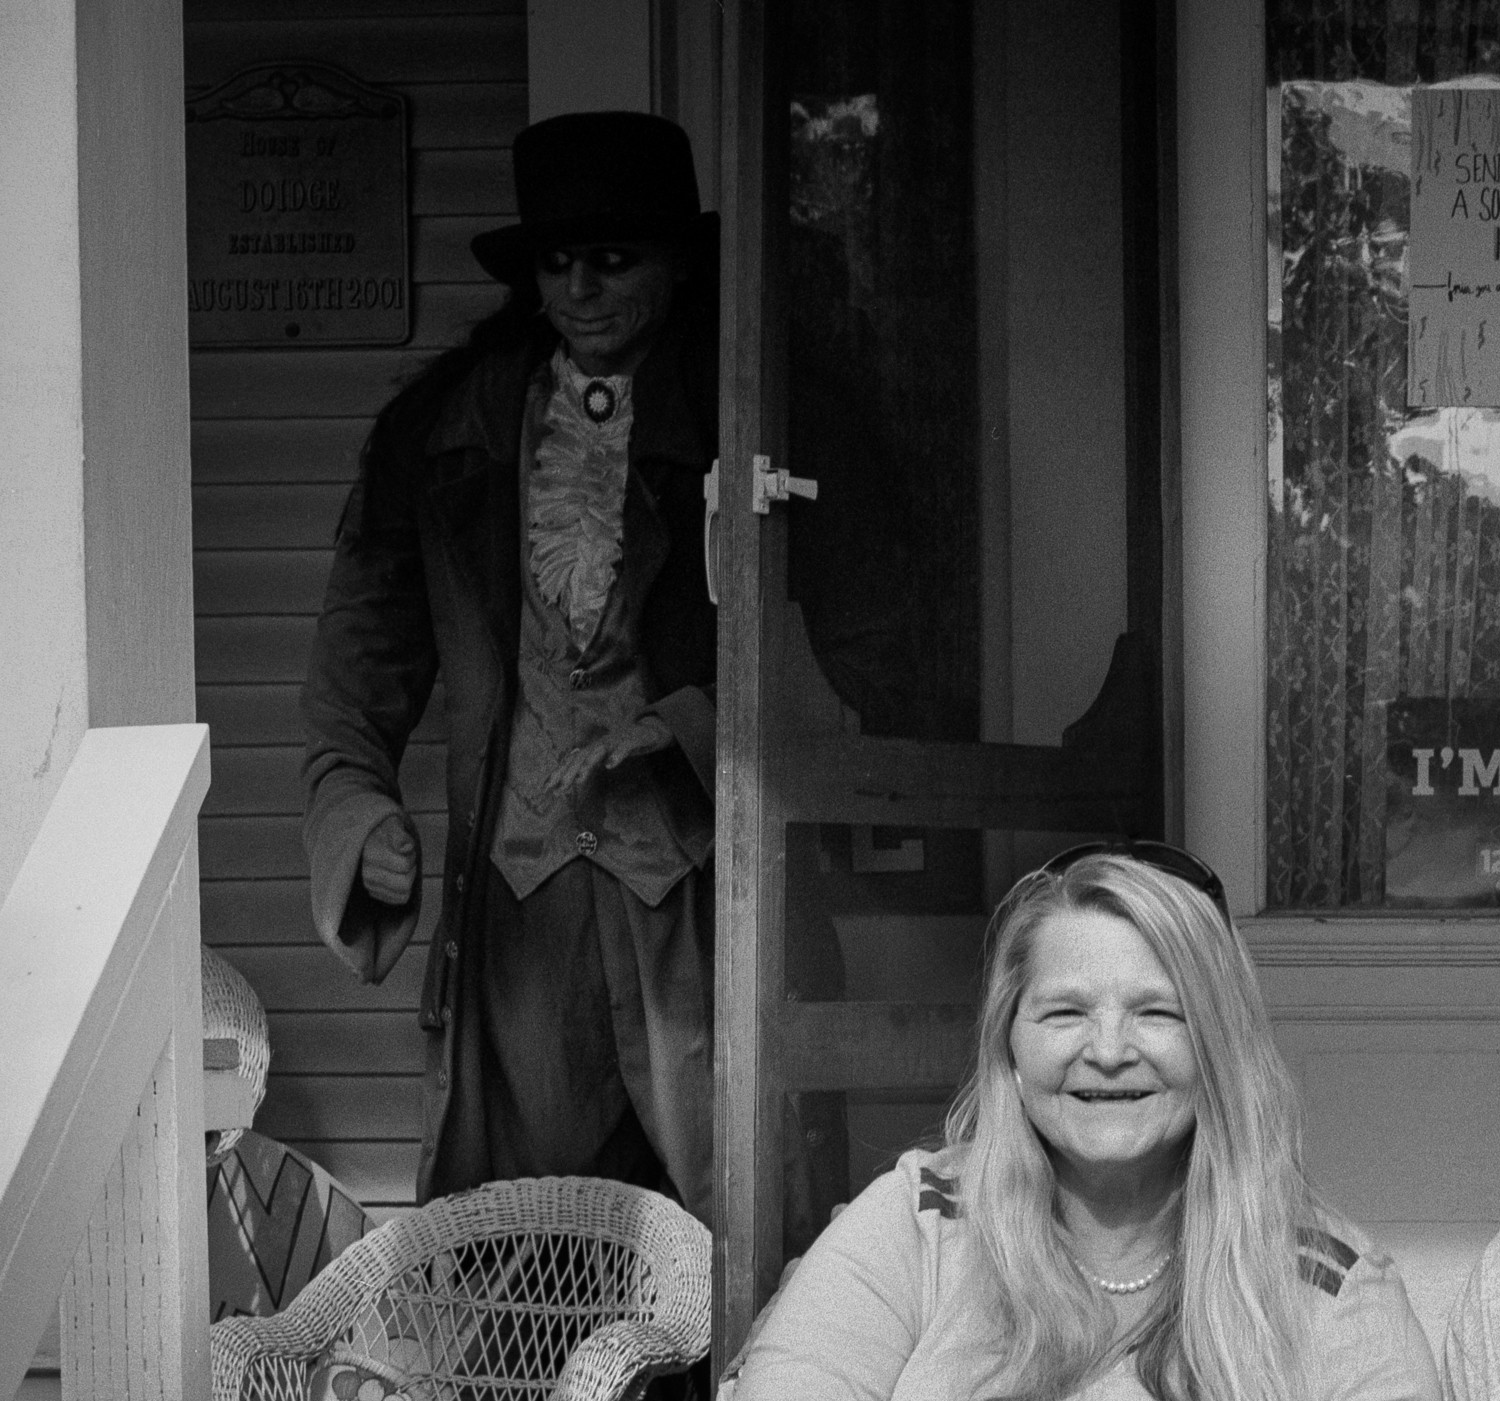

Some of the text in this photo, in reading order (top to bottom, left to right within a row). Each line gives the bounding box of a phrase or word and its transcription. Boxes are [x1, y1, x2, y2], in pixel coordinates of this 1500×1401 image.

[241, 178, 341, 213] DOIDGE
[1451, 188, 1469, 219] A
[228, 232, 356, 256] ESTABLISHED
[188, 278, 280, 312] AUGUST
[346, 277, 405, 311] 2001
